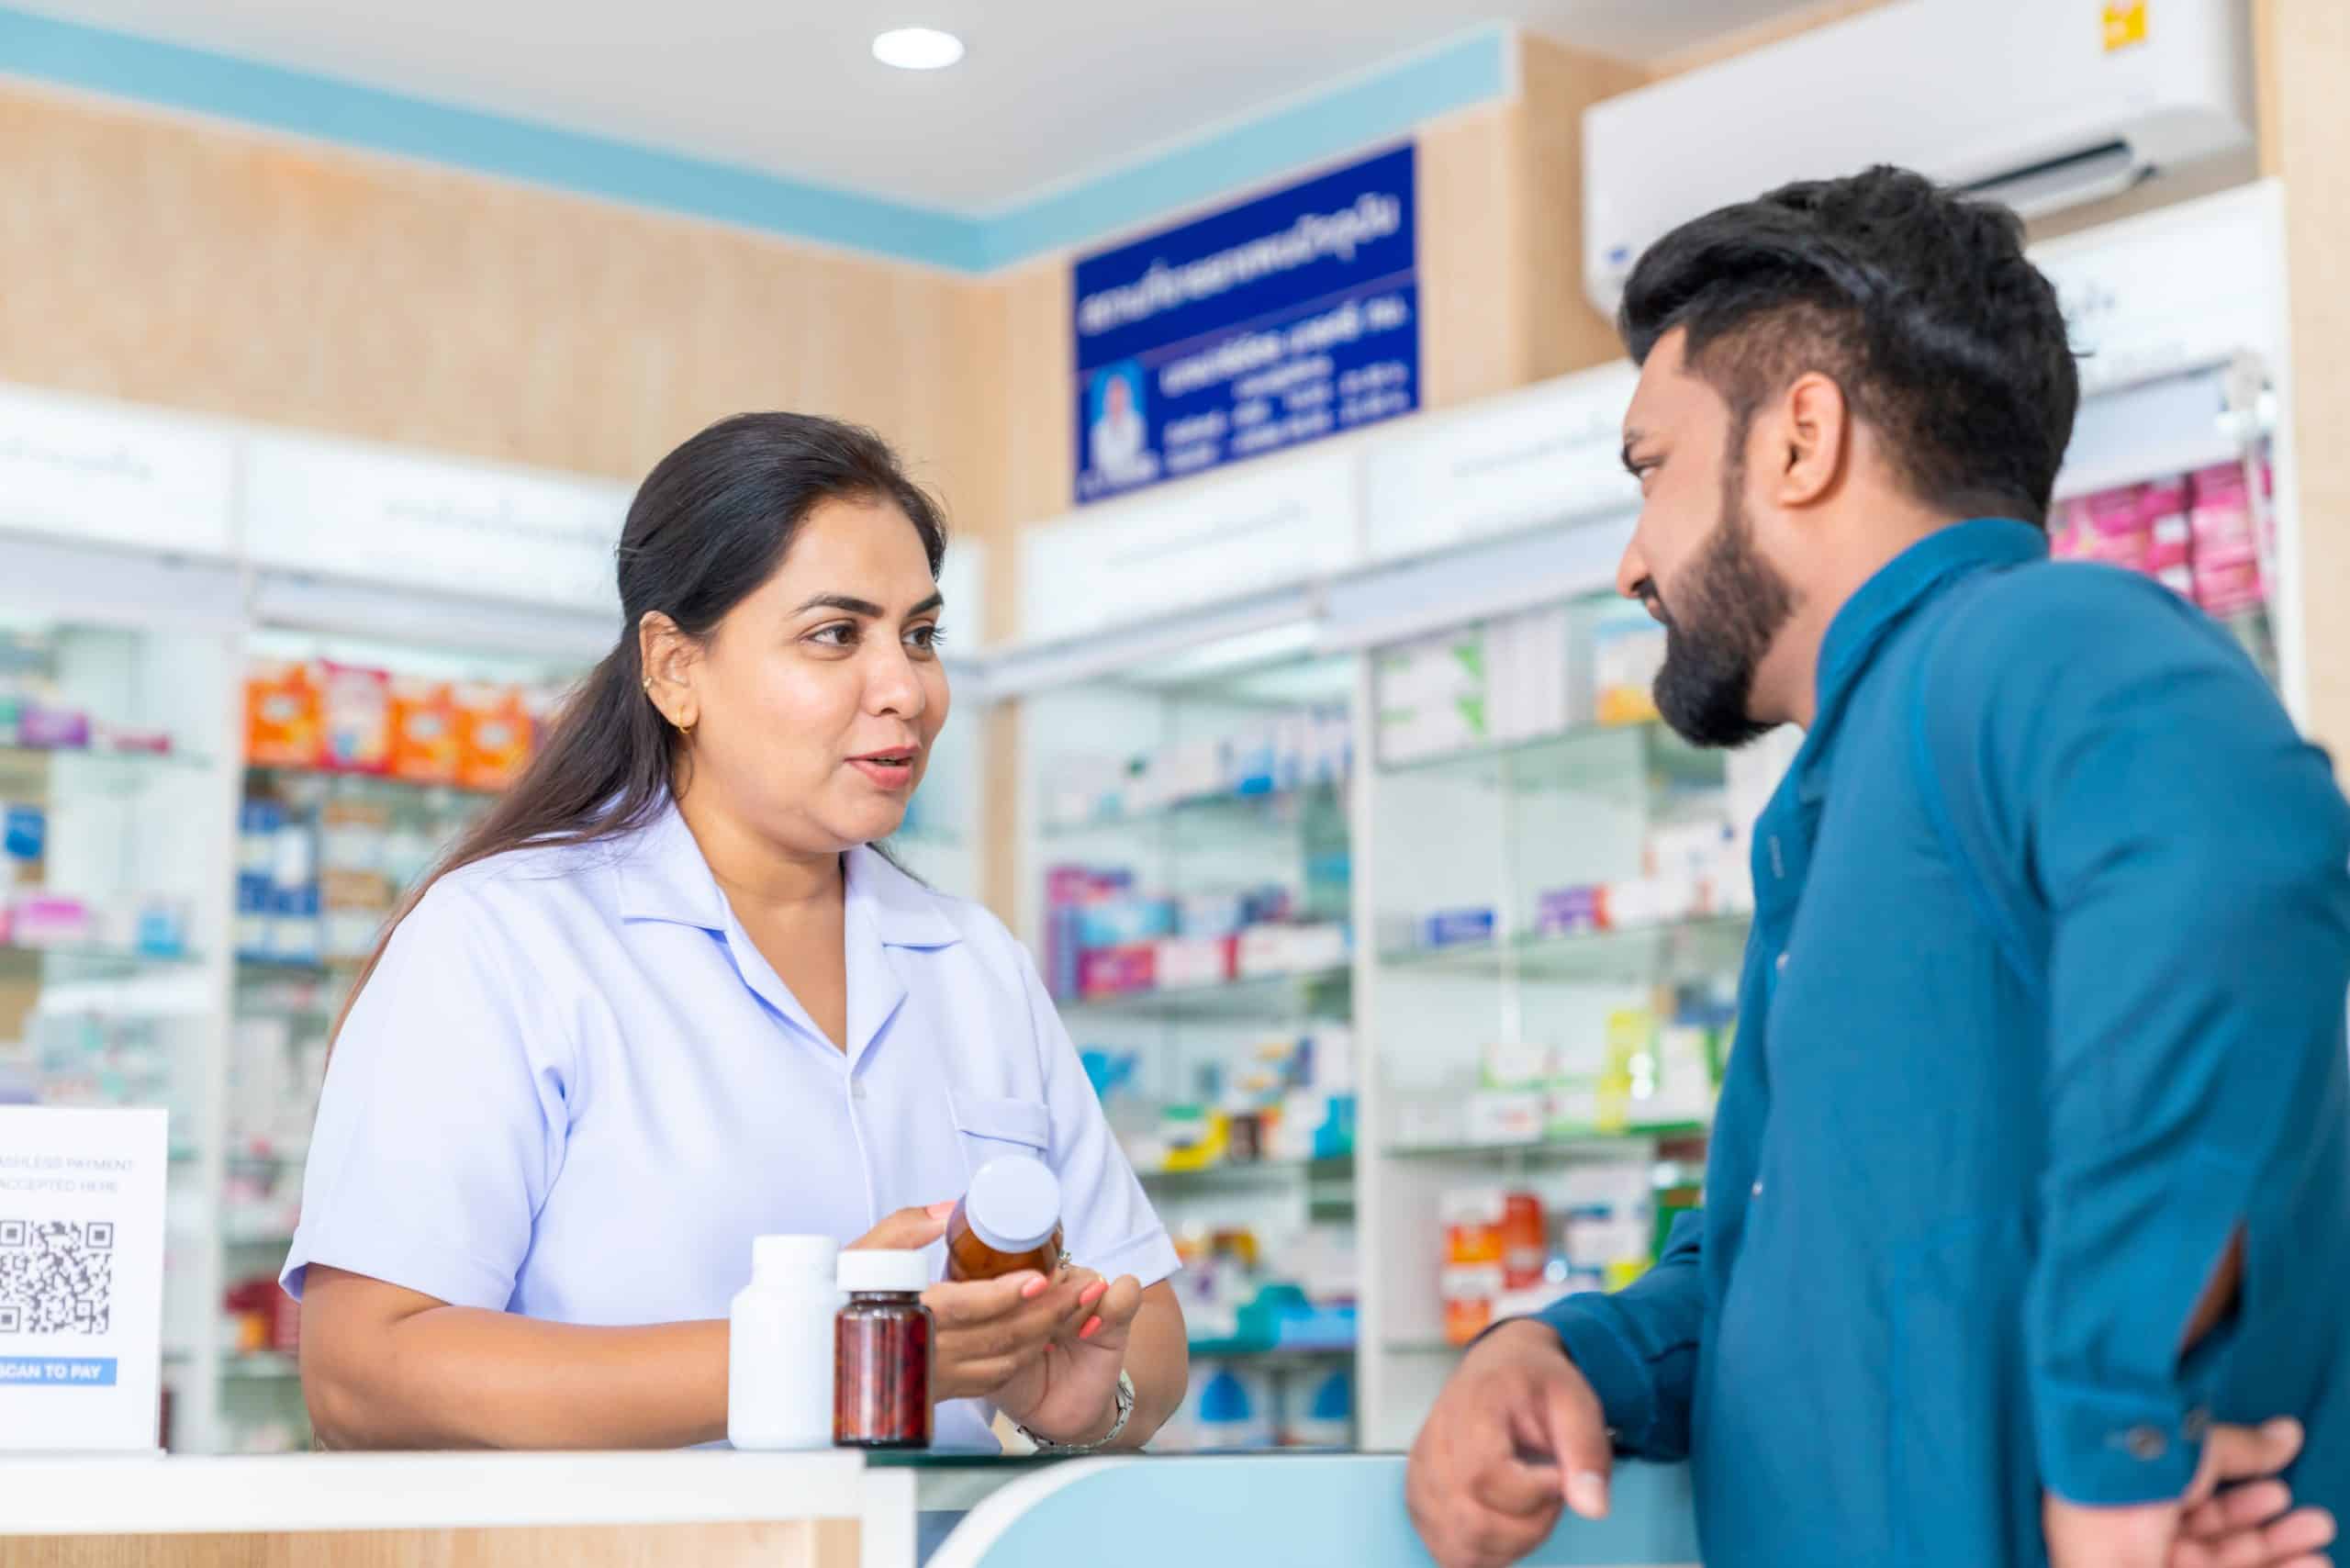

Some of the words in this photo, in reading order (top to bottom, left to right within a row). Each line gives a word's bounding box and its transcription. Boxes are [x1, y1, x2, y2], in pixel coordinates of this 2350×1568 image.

[66, 1157, 134, 1171] PAYMENT
[80, 1180, 118, 1193] HERE
[44, 1363, 67, 1380] TO
[71, 1363, 102, 1381] PAY
